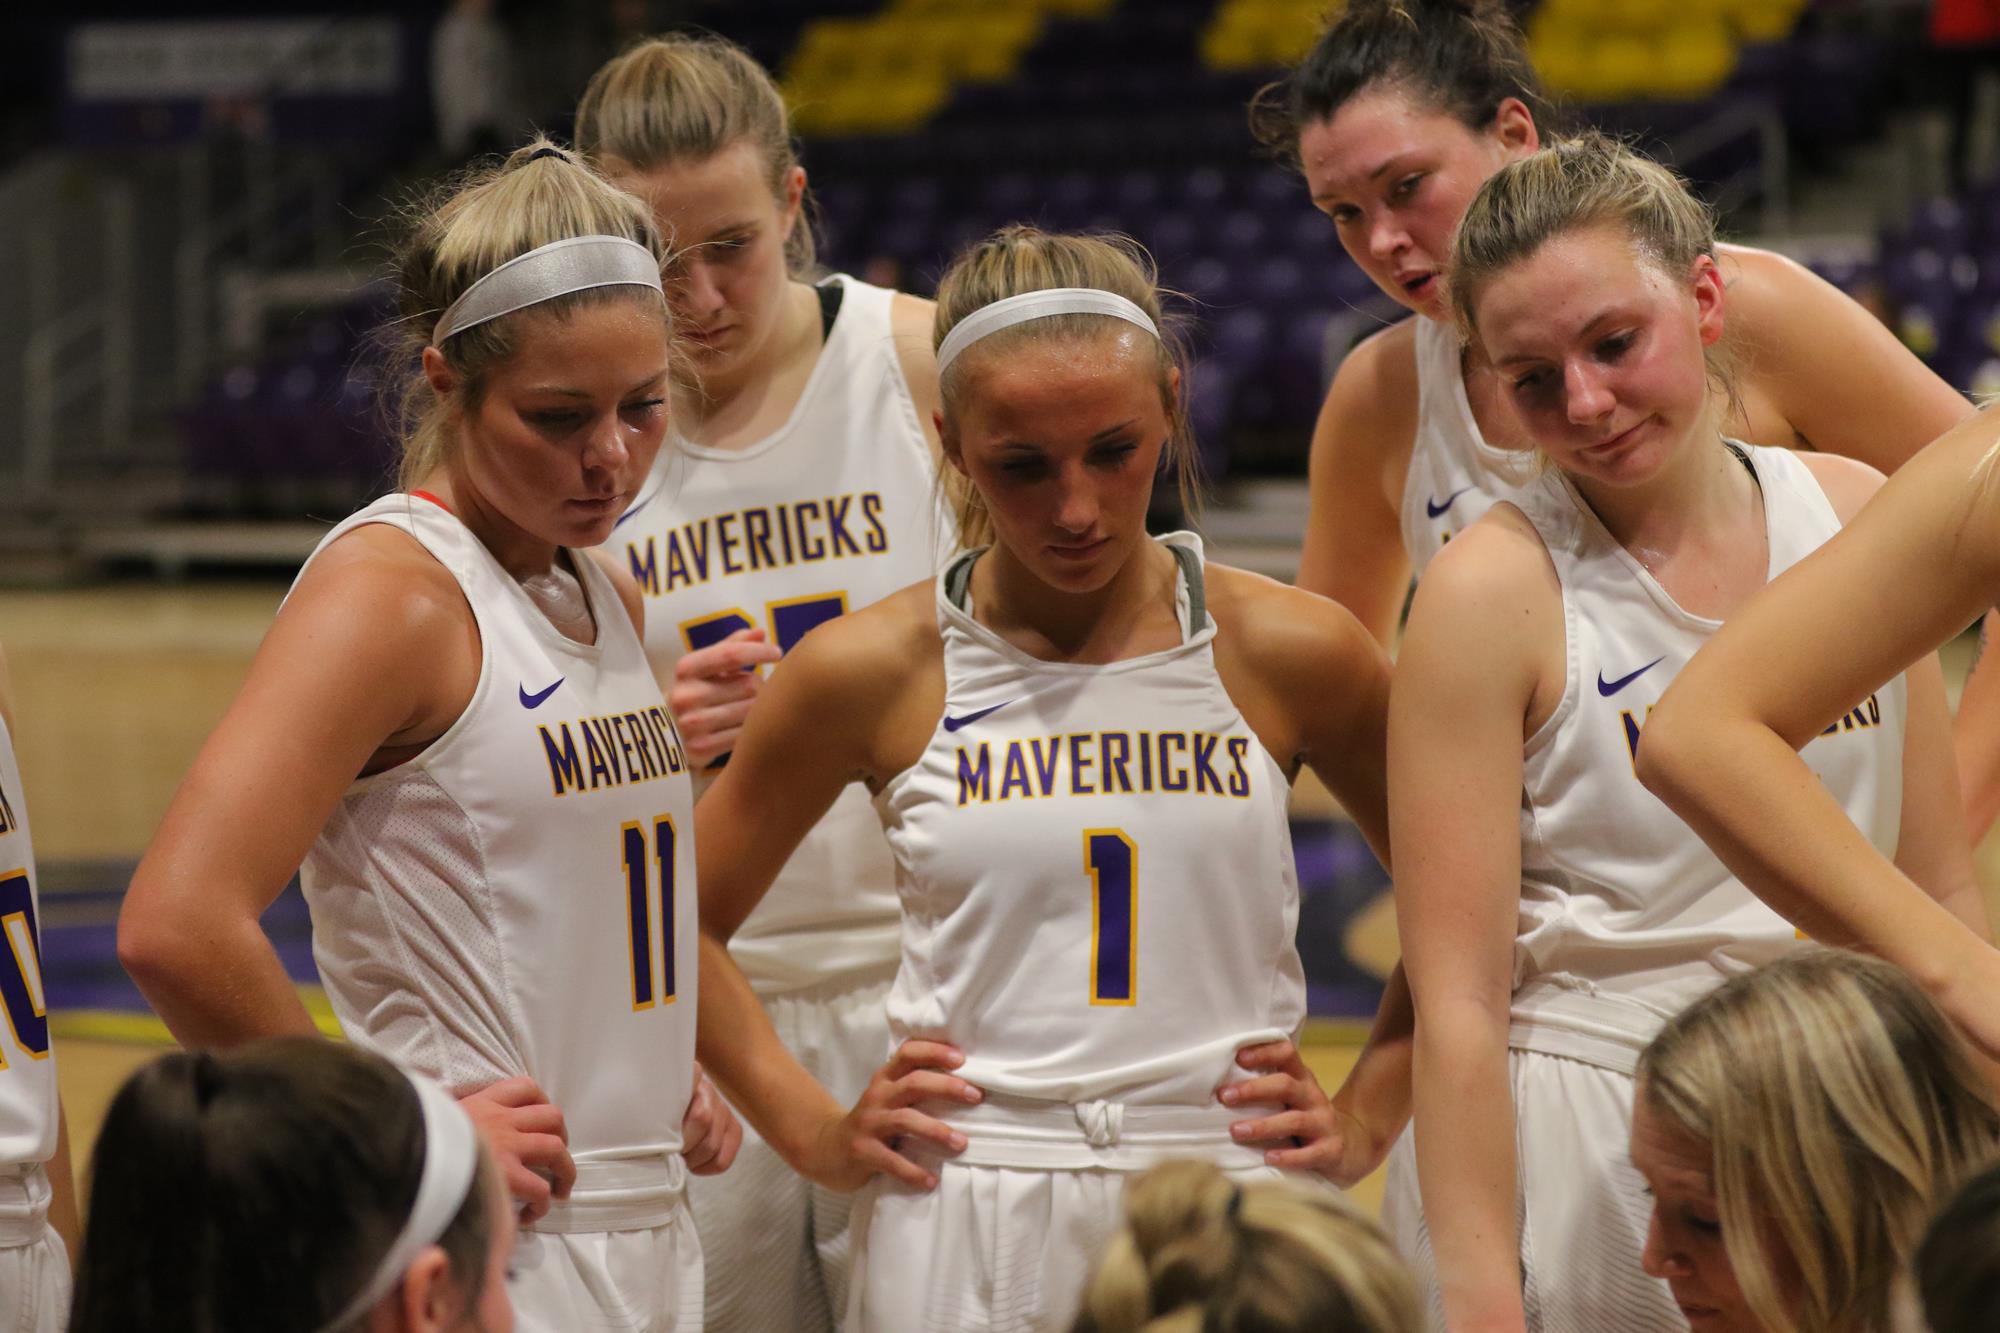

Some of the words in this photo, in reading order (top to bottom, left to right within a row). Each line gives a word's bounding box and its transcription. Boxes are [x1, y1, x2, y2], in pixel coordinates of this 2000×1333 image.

[626, 492, 888, 597] MAVERICKS
[956, 730, 1250, 807] MAVERICKS
[620, 812, 677, 1012] 11
[1082, 827, 1138, 1007] 1
